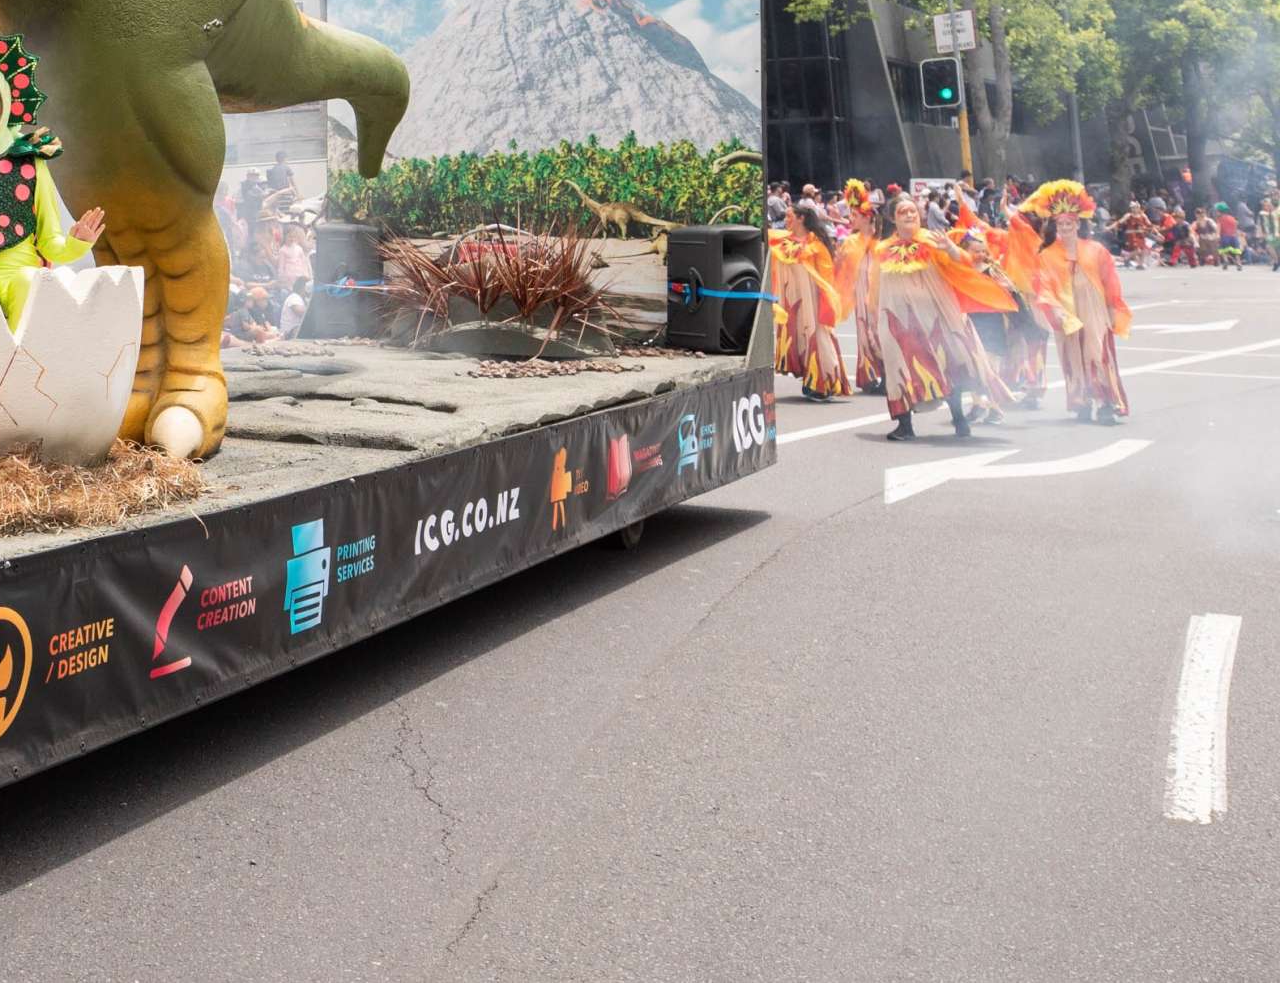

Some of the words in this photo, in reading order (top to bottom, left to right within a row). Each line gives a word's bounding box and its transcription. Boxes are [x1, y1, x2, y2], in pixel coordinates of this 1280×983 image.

[732, 393, 765, 453] ICG
[414, 487, 520, 556] ICG.CO.NZ
[336, 535, 376, 562] PRINTING
[336, 555, 375, 583] SERVICES
[200, 576, 253, 608] CONTENT
[196, 598, 256, 631] CREATION
[49, 618, 114, 656] CREATIVE
[58, 645, 109, 681] DESIGN
